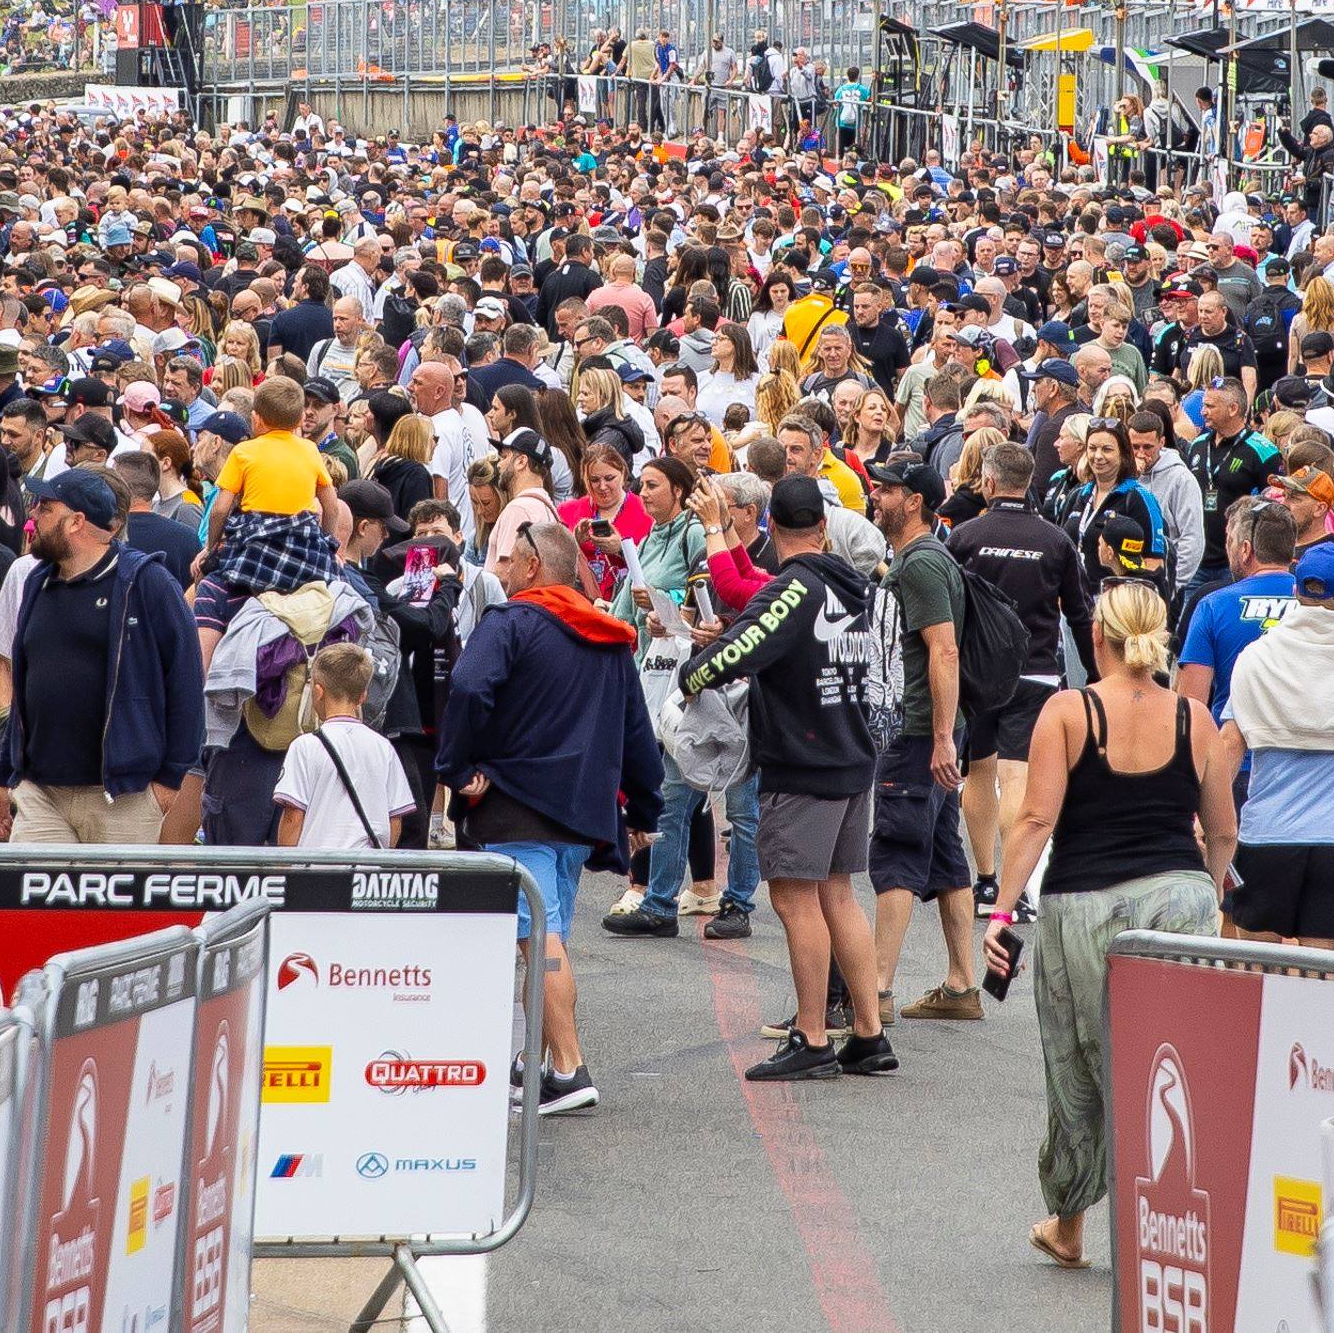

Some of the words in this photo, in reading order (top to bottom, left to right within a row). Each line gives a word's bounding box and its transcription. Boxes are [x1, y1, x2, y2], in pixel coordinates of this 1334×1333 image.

[978, 546, 1044, 560] DAINESE
[711, 624, 767, 672] YOUR
[759, 578, 809, 633] BODY
[20, 872, 134, 906] PARC
[143, 873, 287, 906] FERME
[351, 872, 440, 899] DATATAG
[350, 898, 401, 909] MOTORCYCLE
[401, 898, 438, 909] SECURITY
[328, 962, 432, 987] Bennetts
[371, 1062, 478, 1084] QUATTRO
[394, 1157, 478, 1172] MAXUS
[1138, 1196, 1208, 1257] Bennetts
